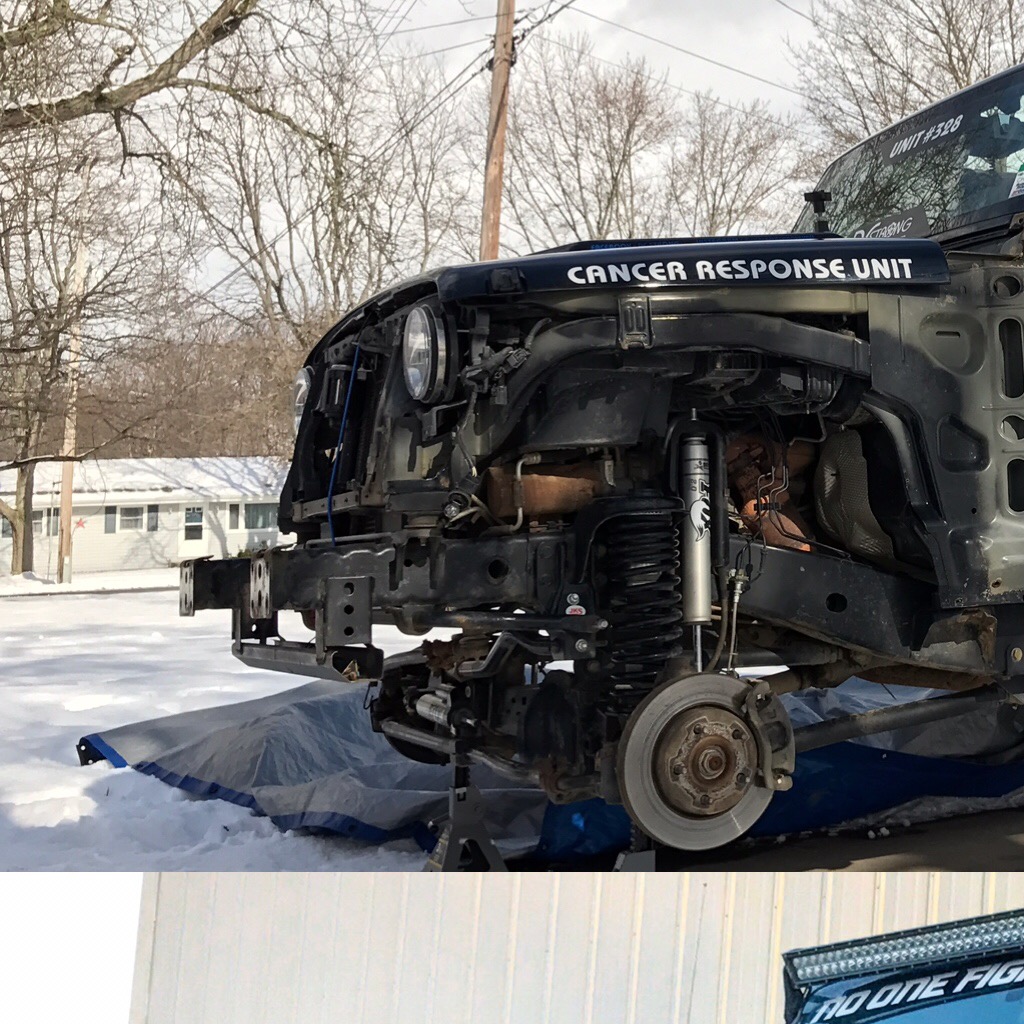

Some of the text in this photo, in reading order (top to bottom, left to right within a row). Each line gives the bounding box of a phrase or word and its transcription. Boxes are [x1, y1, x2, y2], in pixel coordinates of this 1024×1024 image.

[889, 114, 964, 159] UNIT #328
[566, 258, 913, 285] CANCER RESPONSE UNIT
[810, 989, 871, 1024] NO
[866, 972, 959, 1011] ONE
